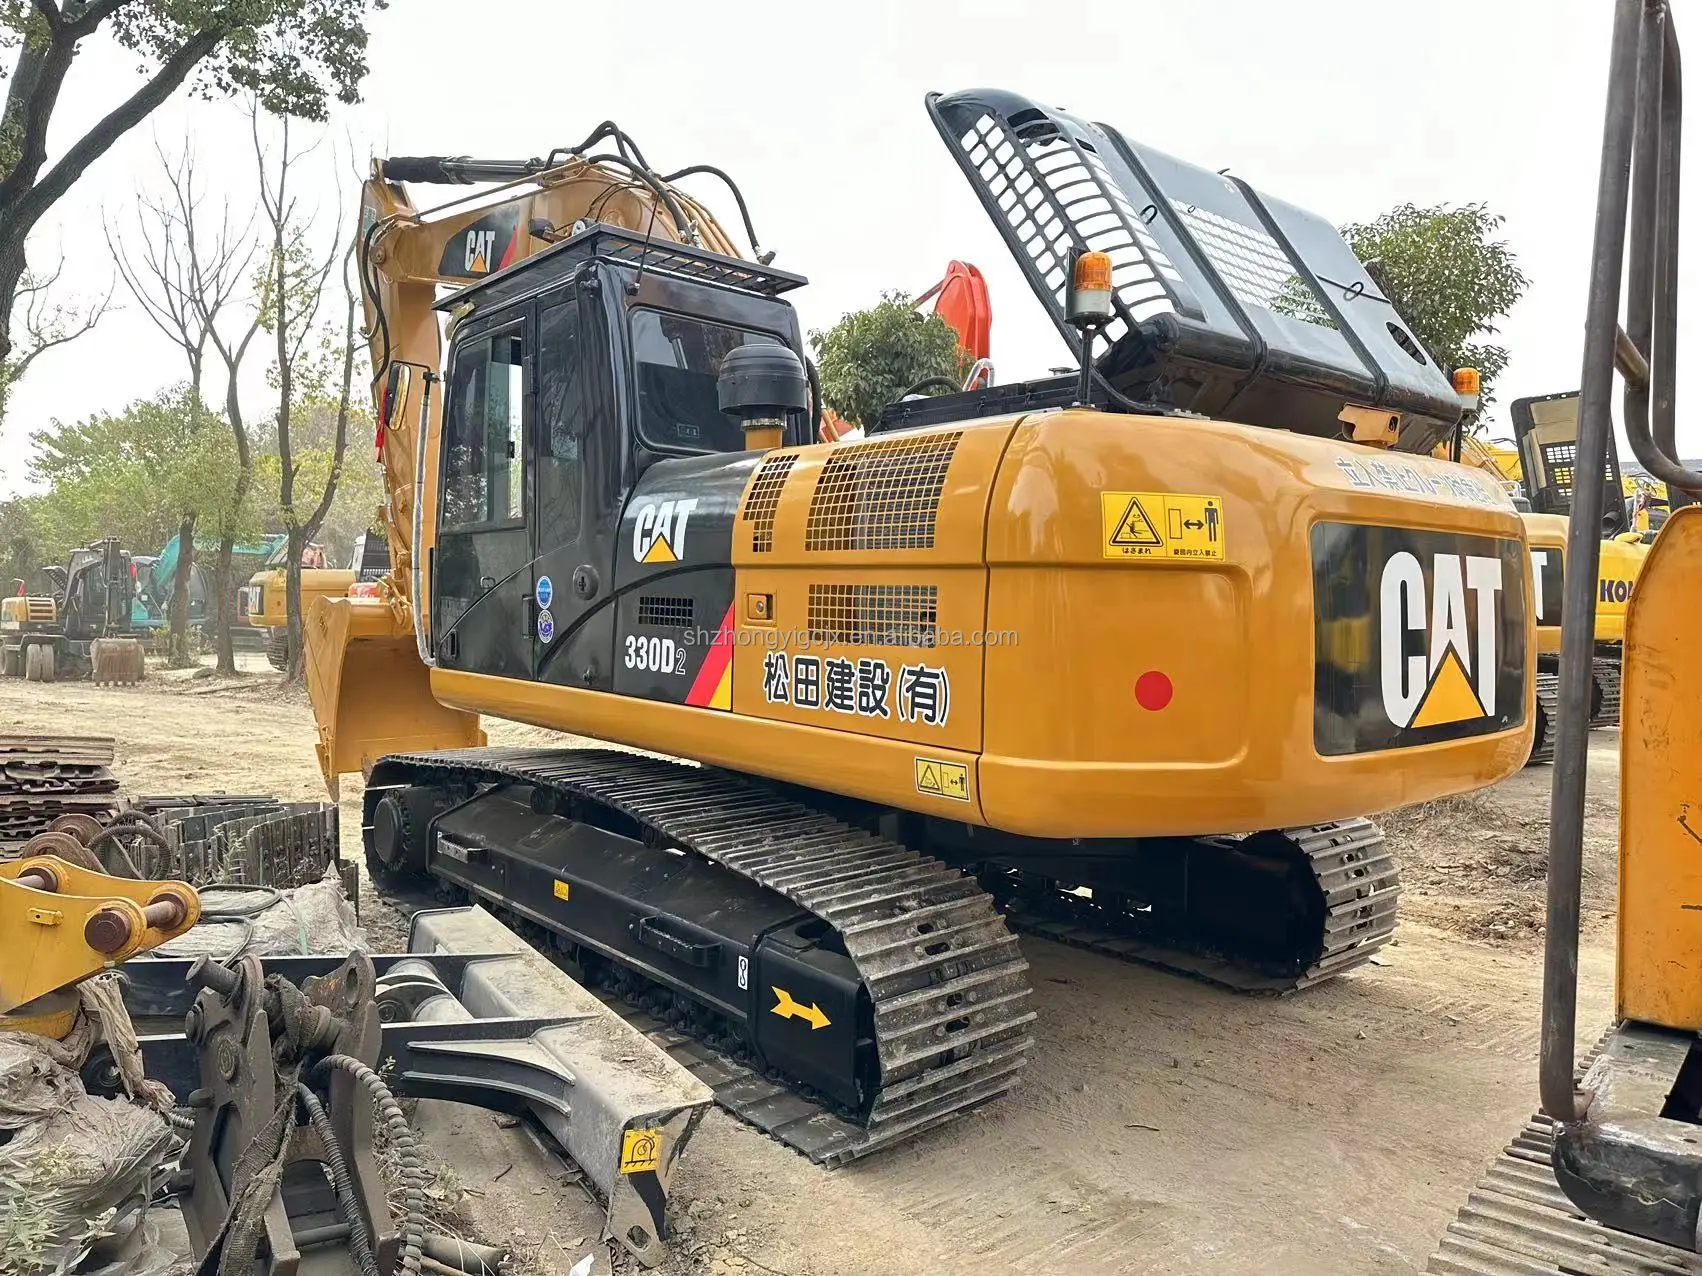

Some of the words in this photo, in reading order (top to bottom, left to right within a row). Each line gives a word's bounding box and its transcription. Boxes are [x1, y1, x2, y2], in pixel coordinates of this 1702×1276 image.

[464, 230, 496, 273] CAT
[633, 498, 698, 564] CAT
[1122, 547, 1152, 555] はさまれ
[1380, 551, 1503, 729] CAT
[763, 652, 951, 727] 松田建設(有)
